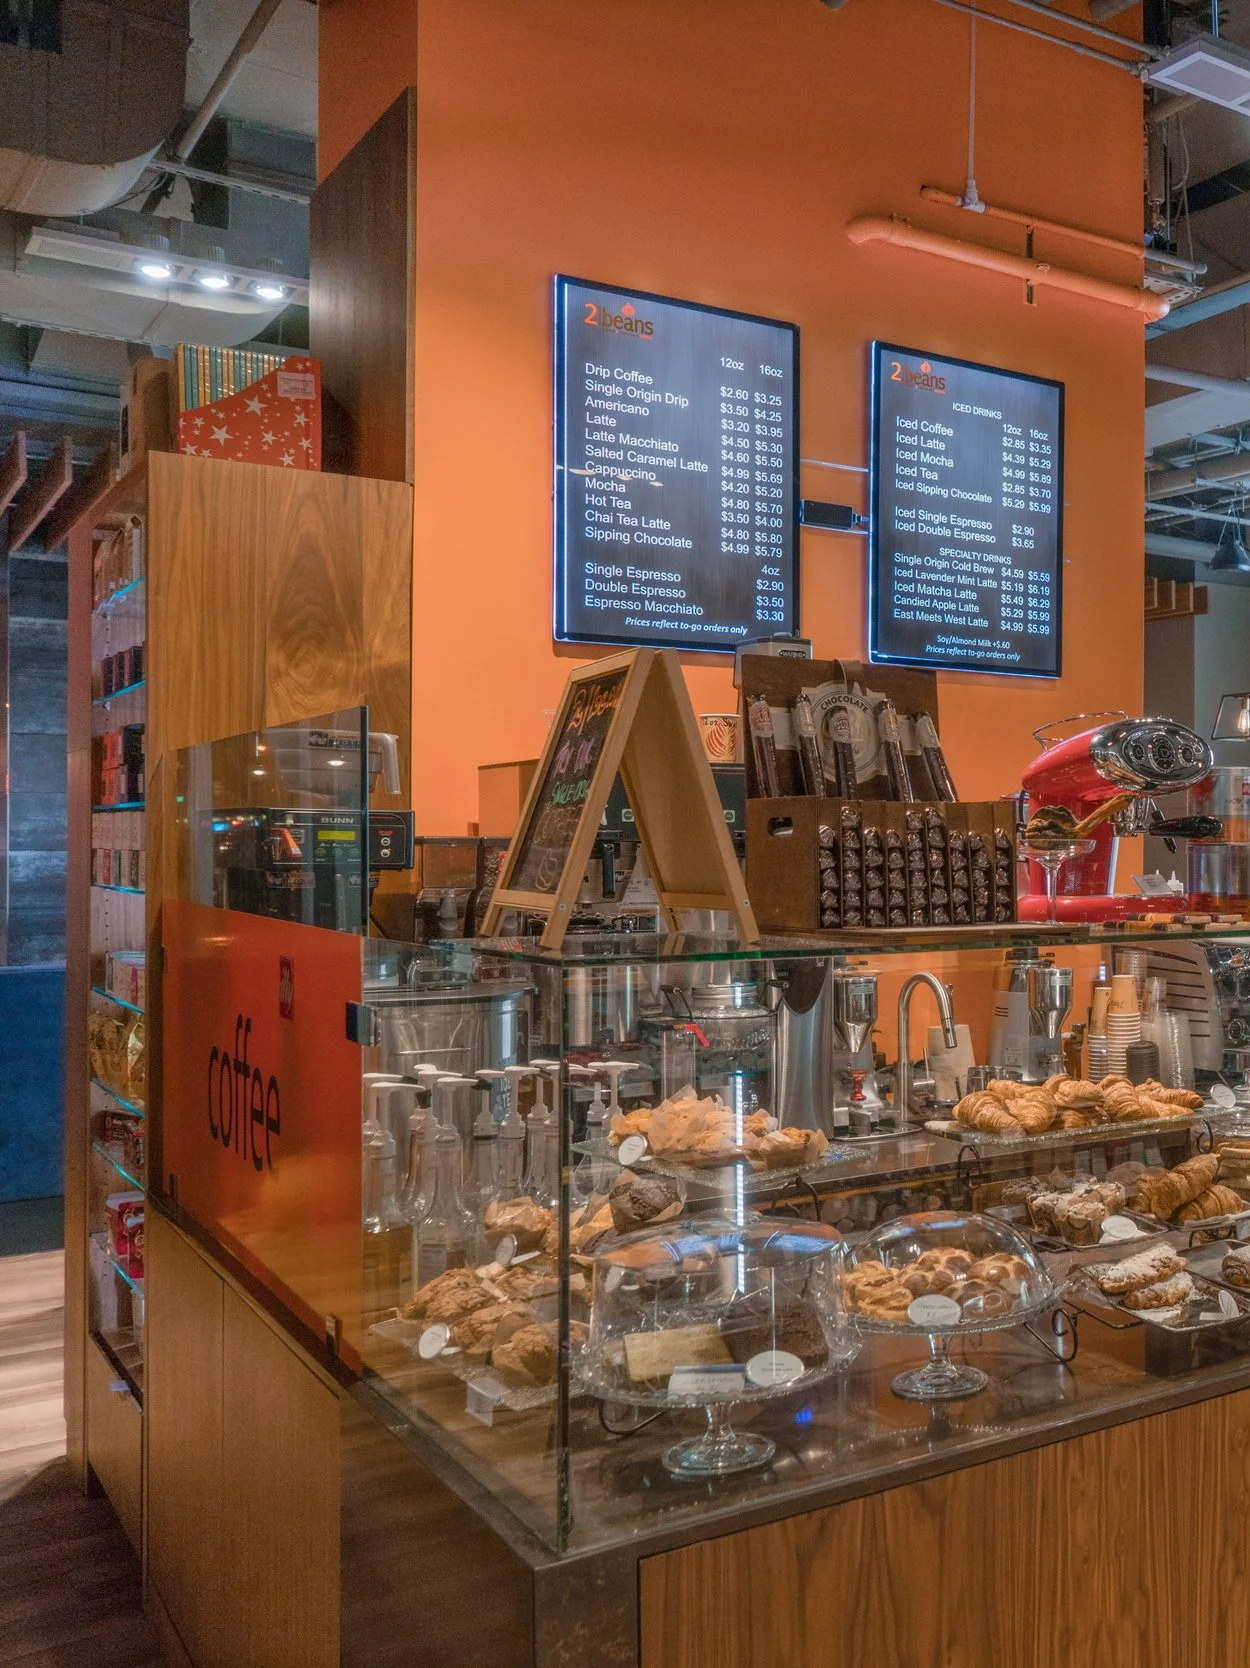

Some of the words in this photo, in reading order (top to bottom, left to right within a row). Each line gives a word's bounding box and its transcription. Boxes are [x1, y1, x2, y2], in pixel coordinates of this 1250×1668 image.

[584, 304, 598, 325] 2
[601, 312, 654, 336] beans
[720, 358, 745, 371] 12oz
[759, 365, 783, 378] 16oz
[891, 362, 901, 381] 2
[904, 366, 945, 390] beans
[586, 363, 610, 378] Drip
[614, 368, 653, 384] Coffee
[721, 387, 748, 400] $2.60
[754, 392, 782, 406] $3.25
[586, 380, 623, 398] Single
[627, 387, 661, 404] Origin
[666, 394, 689, 408] Drip
[721, 403, 748, 417] $3.50
[754, 409, 782, 422] $4.25
[953, 403, 971, 413] ICED
[974, 407, 1002, 419] DRINKS
[585, 397, 649, 416] Americano
[722, 419, 749, 433] $3.20
[755, 425, 783, 438] $3.95
[1003, 424, 1022, 435] 12oz
[1029, 429, 1048, 440] 16oz
[586, 413, 616, 427] Latte
[722, 435, 749, 448] $4.50
[755, 441, 783, 453] $5.30
[586, 429, 615, 443] Latte
[620, 435, 679, 452] Macchiato
[722, 450, 749, 463] $4.60
[755, 455, 783, 467] $5.50
[896, 416, 917, 429] Iced
[921, 422, 954, 436] Coffee
[1003, 437, 1025, 449] $2.85
[1029, 442, 1051, 454] $3.35
[586, 446, 623, 460] Salted
[627, 451, 676, 468] Caramel
[681, 457, 708, 472] Latte
[722, 466, 749, 479] $4.99
[755, 471, 783, 483] $5.69
[896, 432, 917, 445] Iced
[921, 437, 945, 450] Latte
[1002, 452, 1025, 464] $4.39
[1029, 457, 1051, 469] $5.29
[586, 462, 656, 480] Cappuccino
[722, 481, 749, 494] $4.20
[755, 486, 783, 498] $5.20
[896, 448, 917, 461] Iced
[921, 453, 954, 467] Mocha
[1002, 467, 1025, 479] $4.99
[1029, 472, 1051, 484] $5.89
[586, 478, 625, 493] Mocha
[721, 498, 749, 510] $4.80
[755, 502, 783, 514] $5.70
[896, 464, 917, 476] Iced
[920, 468, 938, 480] Tea
[1002, 483, 1025, 494] $2.85
[1029, 487, 1051, 499] $3.70
[896, 479, 914, 490] Iced
[917, 483, 948, 498] Sipping
[951, 489, 992, 503] Chocolate
[1002, 497, 1024, 509] $5.29
[1029, 501, 1051, 513] $5.99
[586, 494, 606, 507] Hot
[610, 497, 631, 509] Tea
[722, 511, 749, 524] $3.50
[755, 516, 783, 528] $4.00
[895, 506, 915, 518] Iced
[918, 510, 947, 524] Single
[951, 515, 992, 530] Espresso
[1012, 524, 1034, 536] $2.90
[586, 510, 613, 524] Chai
[617, 514, 638, 526] Tea
[642, 517, 671, 529] Latte
[721, 528, 749, 540] $4.80
[755, 532, 783, 544] $5.80
[895, 520, 915, 532] Iced
[918, 523, 951, 536] Double
[954, 529, 996, 543] Espresso
[1012, 537, 1034, 549] $3.65
[586, 527, 630, 544] Sipping
[634, 532, 692, 548] Chocolate
[721, 542, 749, 554] $4.99
[755, 546, 782, 558] $5.79
[939, 548, 981, 561] SPECIALTY
[983, 554, 1011, 565] DRINKS
[586, 563, 623, 578] Single
[627, 567, 681, 582] Espresso
[757, 580, 784, 591] $2.90
[761, 566, 780, 575] 4oz
[894, 553, 922, 567] Single
[924, 557, 949, 570] Origin
[952, 561, 971, 571] Cold
[974, 564, 994, 574] Brew
[1001, 568, 1024, 579] $4.59
[1028, 572, 1050, 583] $5.59
[894, 567, 912, 577] Iced
[916, 569, 955, 583] Lavender
[958, 575, 975, 586] Mint
[978, 577, 997, 588] Latte
[1001, 581, 1024, 592] $5.19
[1028, 585, 1050, 596] $6.19
[586, 579, 627, 594] Double
[632, 584, 686, 598] Espresso
[757, 596, 784, 607] $3.50
[894, 581, 914, 592] Iced
[917, 584, 951, 596] Matcha
[955, 588, 977, 599] Latte
[1001, 594, 1023, 605] $5.49
[1028, 598, 1050, 609] $6.29
[894, 595, 930, 607] Candied
[932, 599, 956, 611] Apple
[959, 601, 979, 613] Latte
[1001, 607, 1023, 618] $5.29
[1028, 611, 1050, 621] $5.99
[586, 596, 641, 611] Espresso
[645, 601, 703, 615] Macchiato
[757, 610, 784, 621] $3.30
[894, 609, 914, 620] East
[916, 611, 942, 623] Meets
[944, 614, 966, 625] West
[968, 616, 988, 627] Latte
[1001, 621, 1023, 632] $4.99
[1027, 624, 1049, 635] $5.99
[625, 617, 650, 626] Prices
[652, 619, 678, 629] reflect
[680, 621, 702, 631] to-go
[704, 623, 729, 633] orders
[731, 626, 748, 635] only
[937, 635, 976, 646] Soy/Almond
[978, 638, 991, 647] Milk
[926, 645, 945, 654] Prices
[947, 646, 966, 657] reflect
[968, 649, 985, 658] to-go
[986, 651, 1006, 660] orders
[1007, 653, 1020, 661] only
[821, 696, 869, 713] CHOCOLATE
[209, 1014, 280, 1181] coffee
